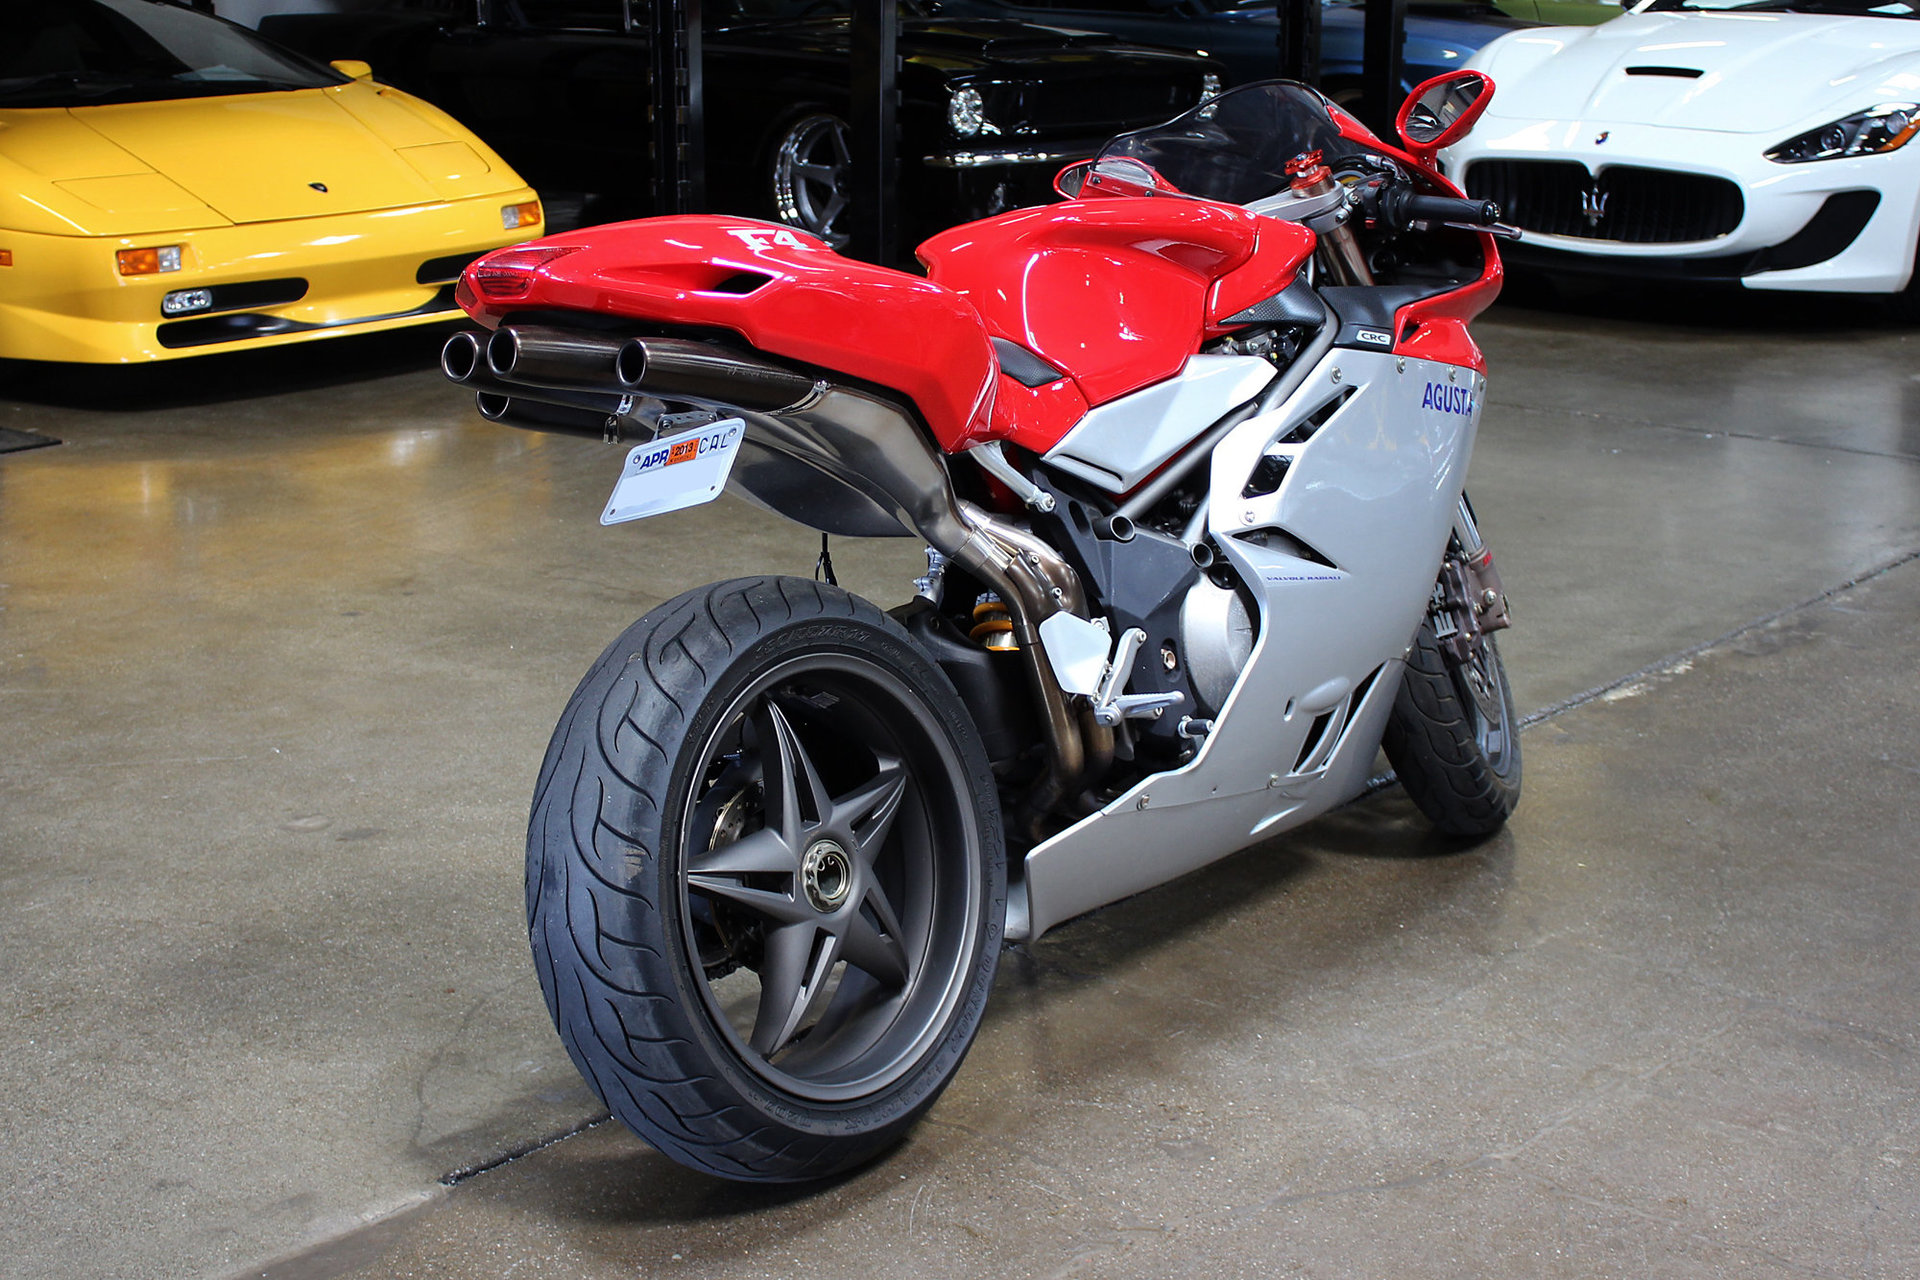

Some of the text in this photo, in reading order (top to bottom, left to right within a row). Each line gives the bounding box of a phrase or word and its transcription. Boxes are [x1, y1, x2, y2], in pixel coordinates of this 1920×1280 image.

[726, 229, 817, 251] F4
[1361, 332, 1387, 342] CRC
[1421, 382, 1473, 418] AGUSTA
[674, 442, 694, 457] 2013
[698, 433, 729, 454] CAL
[639, 449, 670, 470] APR
